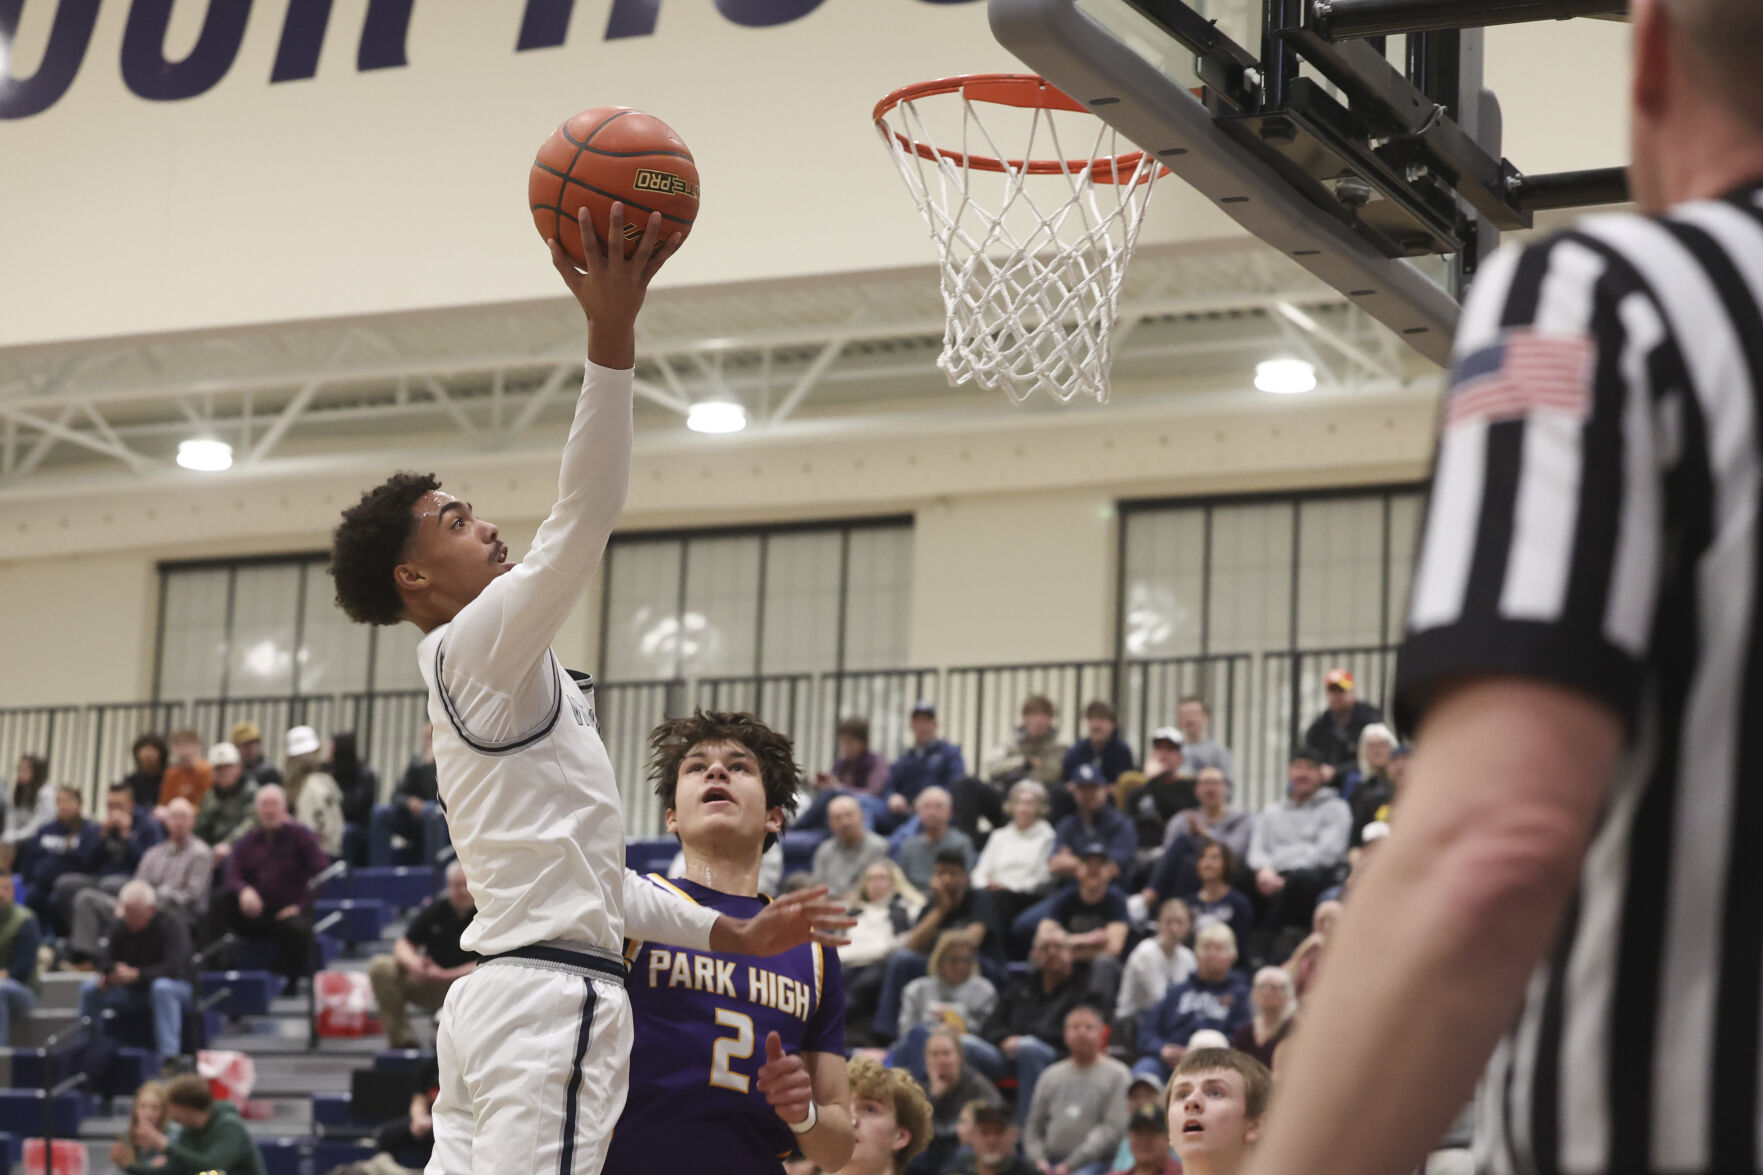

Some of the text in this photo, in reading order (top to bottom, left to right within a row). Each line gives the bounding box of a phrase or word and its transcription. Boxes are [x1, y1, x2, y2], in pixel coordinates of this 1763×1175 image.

[649, 949, 810, 1022] PARK HIGH
[709, 1007, 755, 1094] 2
